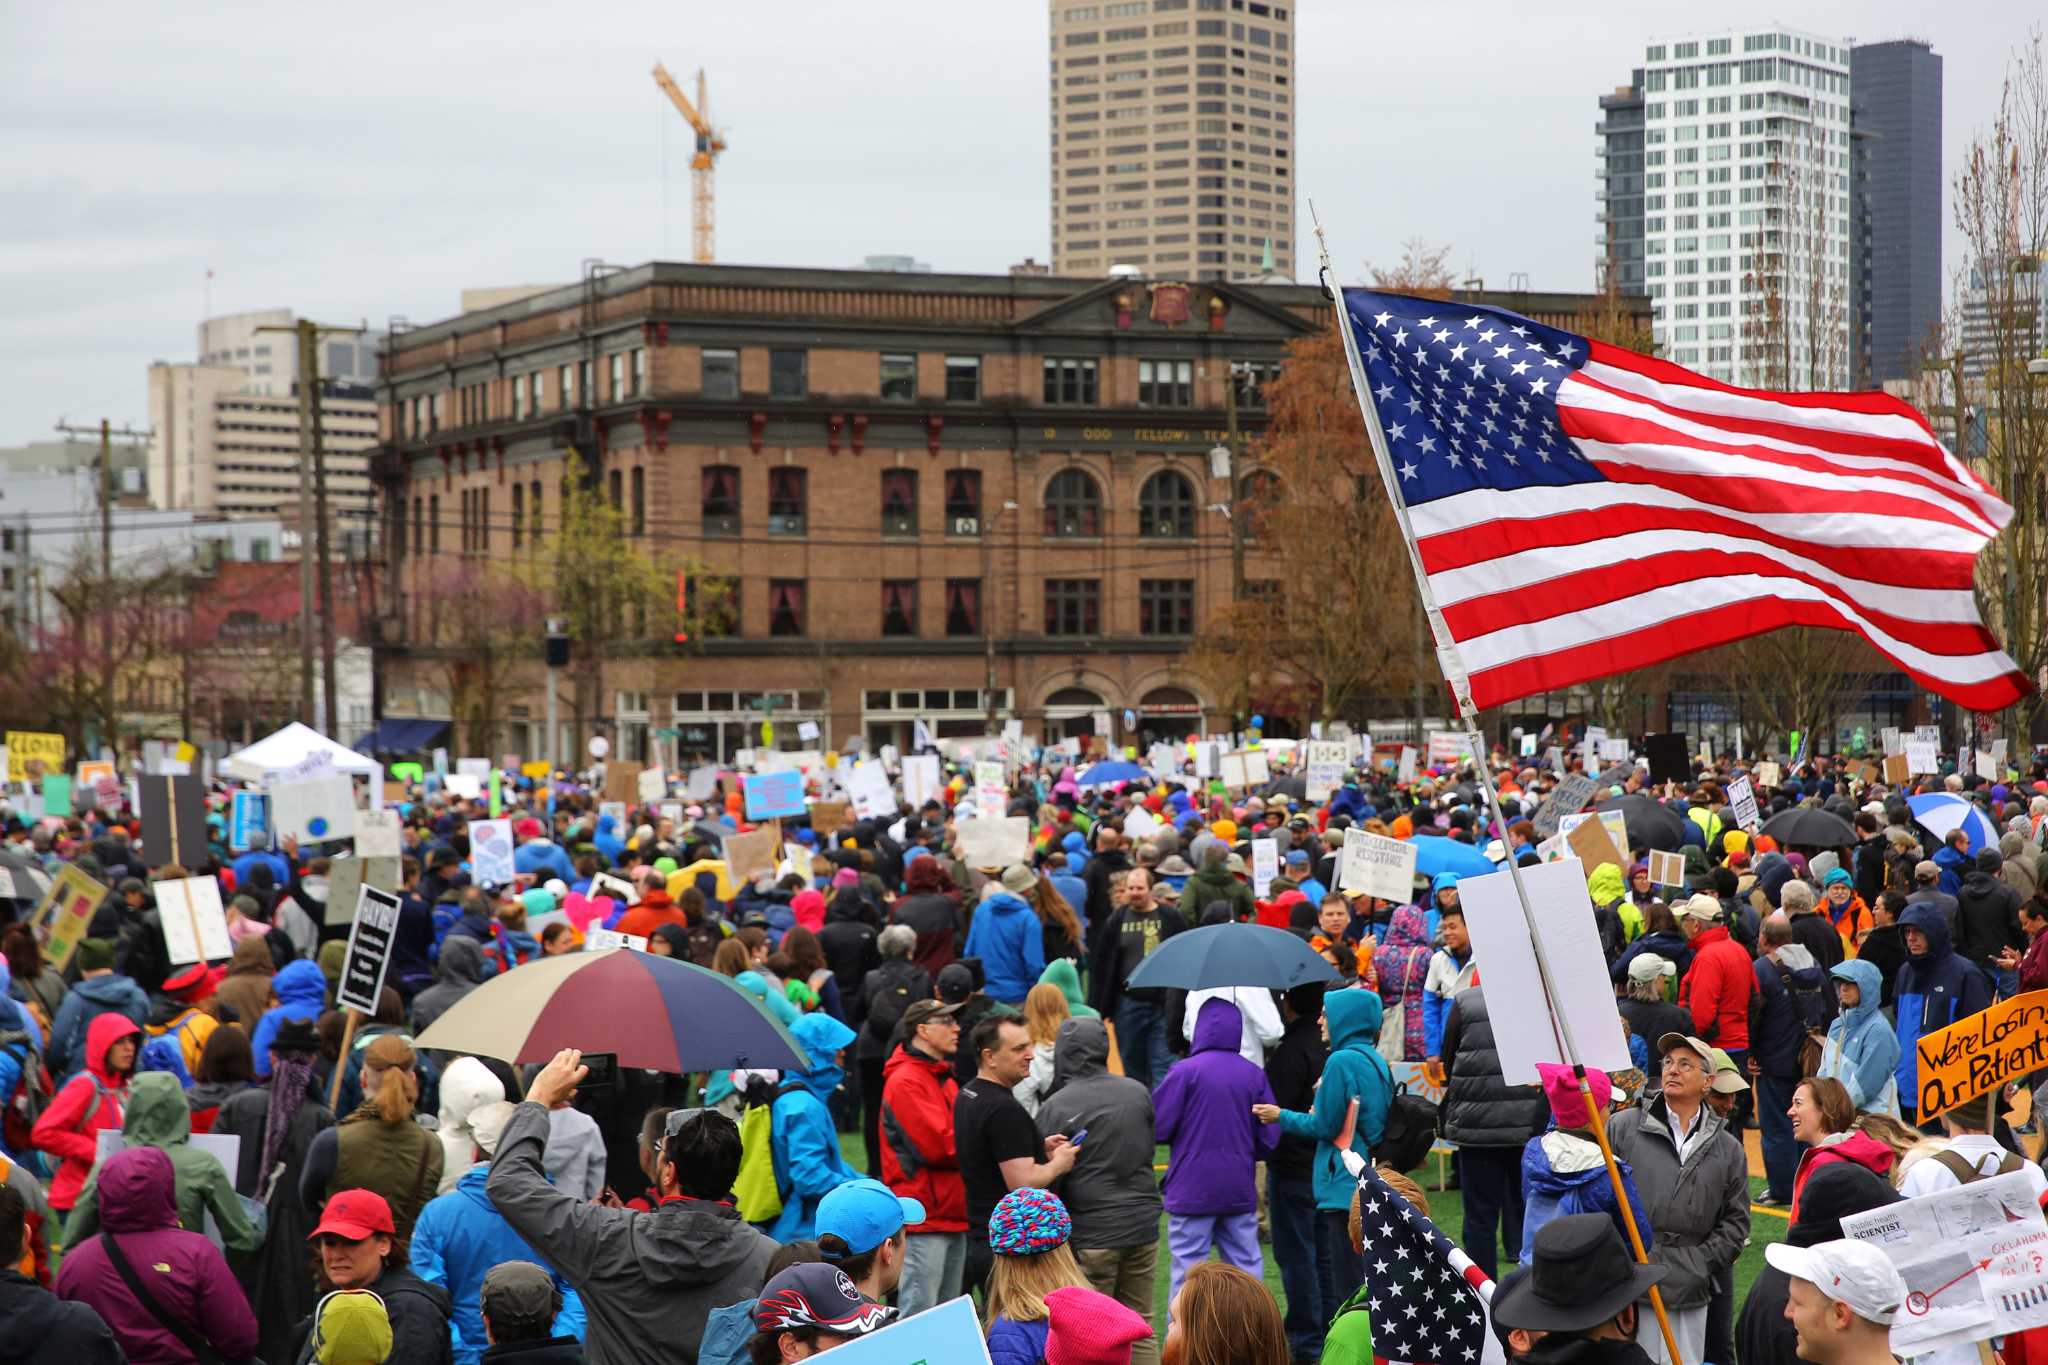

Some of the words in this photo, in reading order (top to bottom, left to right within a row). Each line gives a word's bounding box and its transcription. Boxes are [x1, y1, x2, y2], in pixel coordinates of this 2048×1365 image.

[1134, 428, 1192, 442] FELLOWS
[1203, 429, 1254, 443] TEMLE
[1918, 1031, 1979, 1072] We're
[1982, 1005, 2048, 1048] Losin
[1922, 1078, 1967, 1118] Our
[1850, 1218, 1873, 1231] Public
[1874, 1212, 1898, 1225] health
[1854, 1222, 1901, 1240] SCIENTIST
[1991, 1231, 2048, 1255] OKLAHOMA
